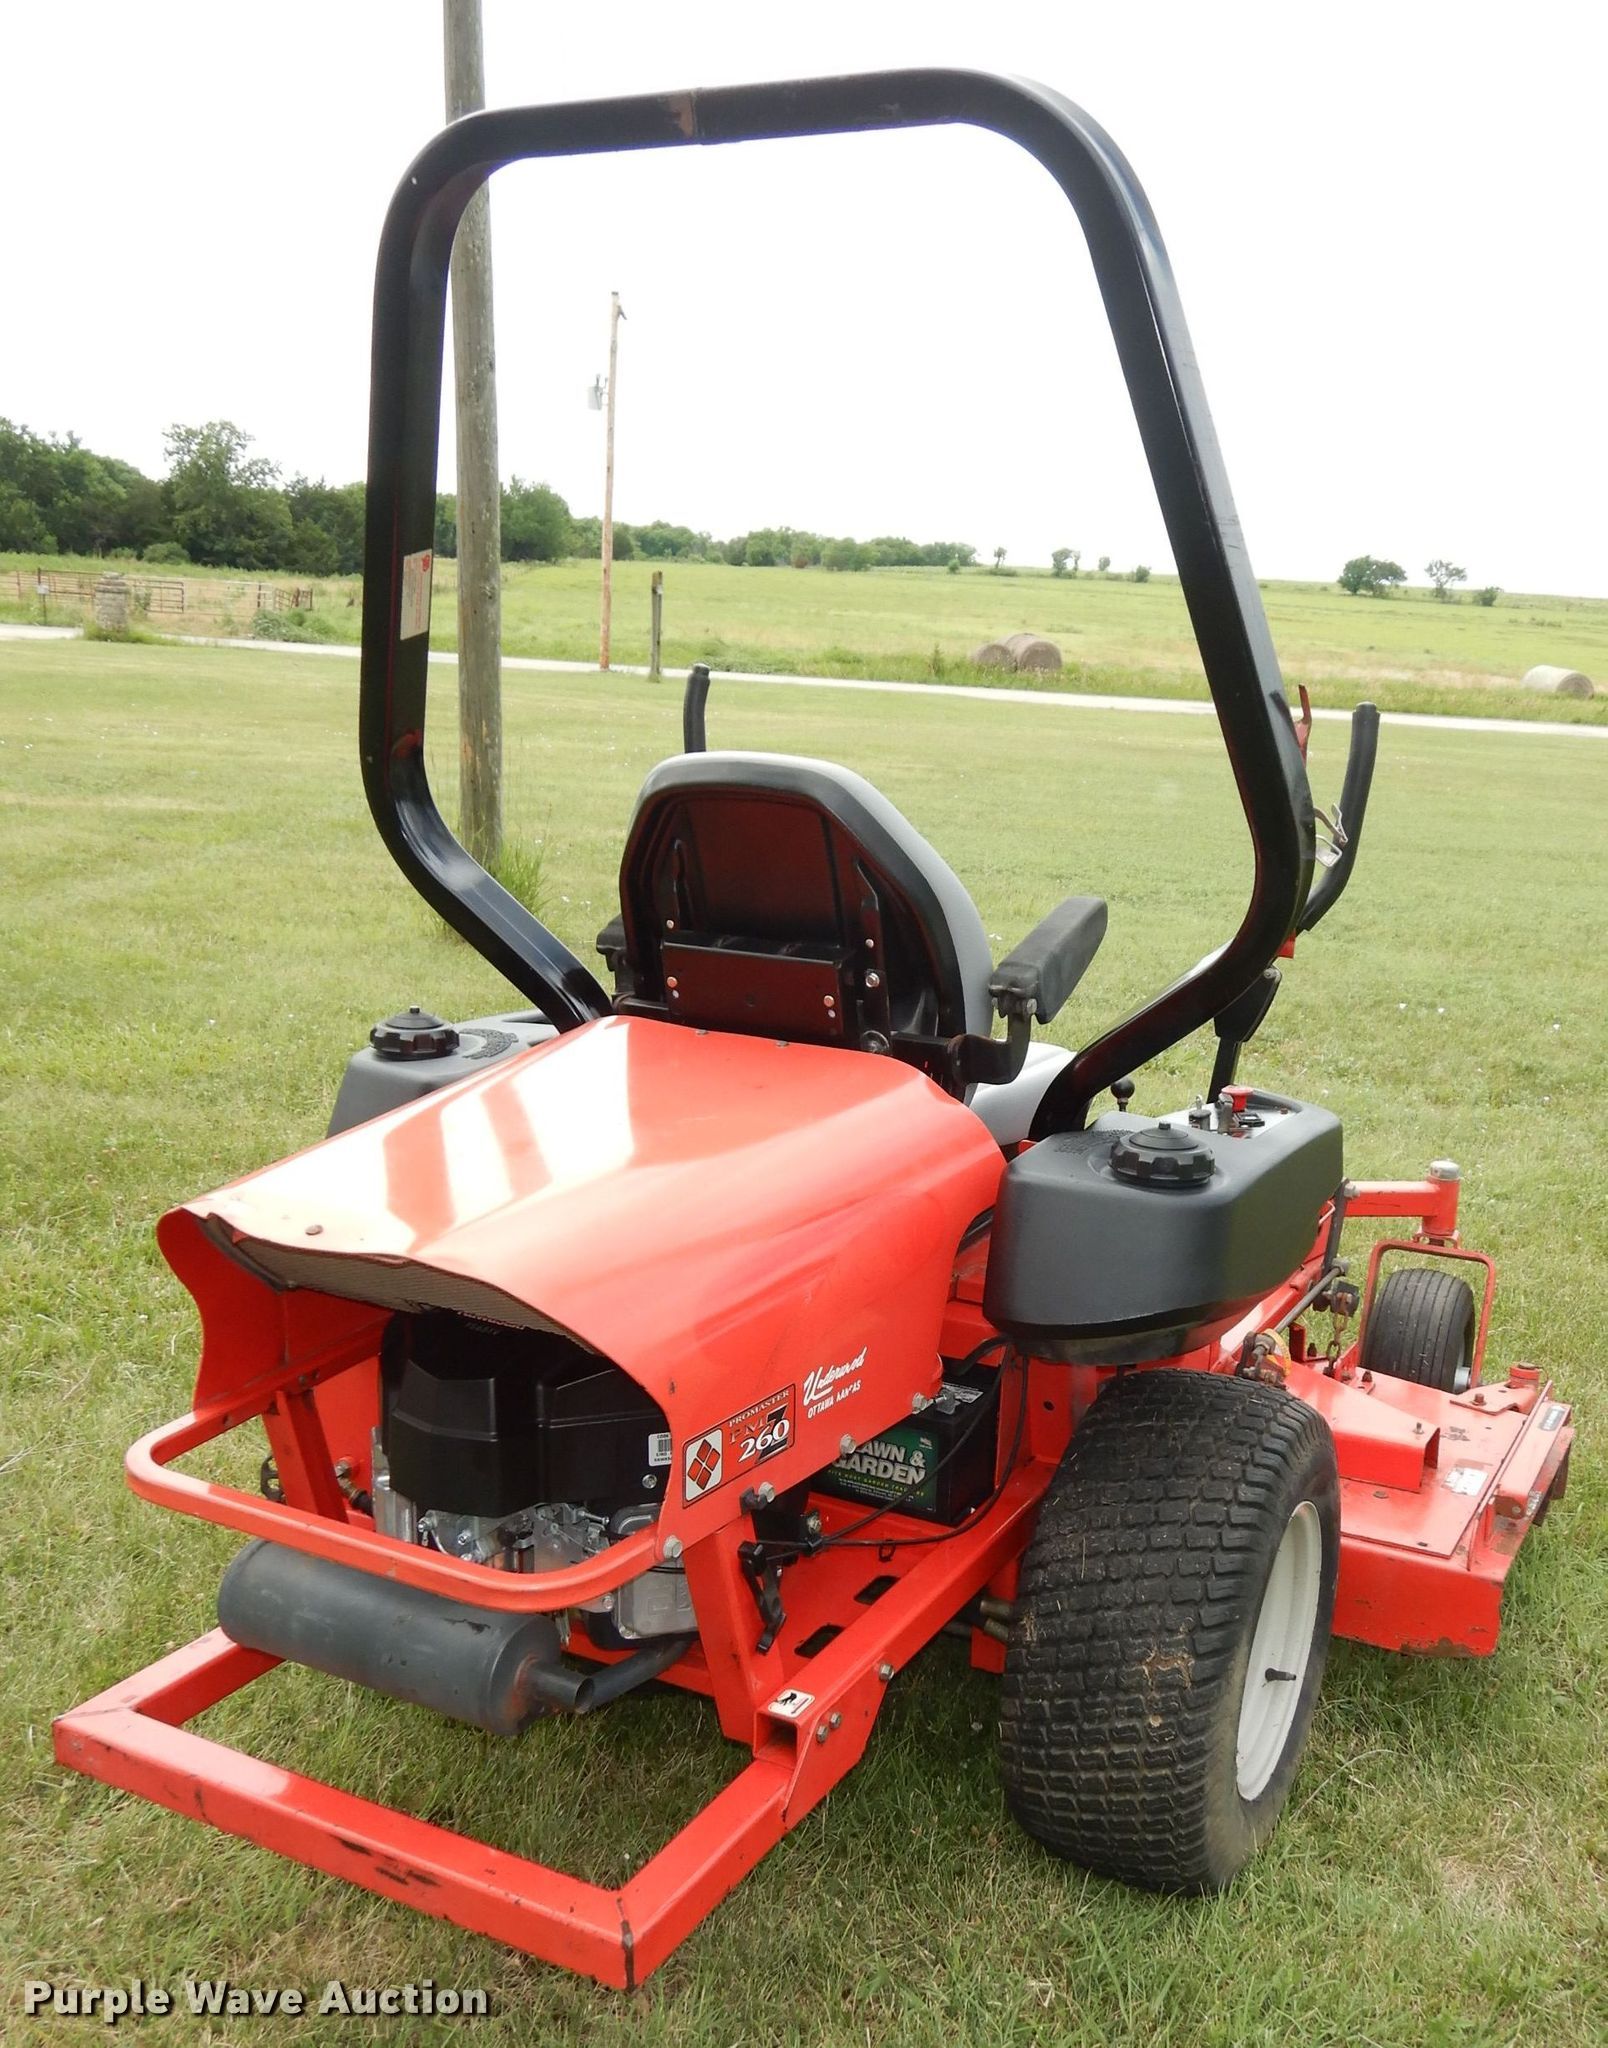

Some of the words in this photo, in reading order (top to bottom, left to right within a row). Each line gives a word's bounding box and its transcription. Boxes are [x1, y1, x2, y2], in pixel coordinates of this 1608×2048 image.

[729, 1390, 789, 1428] PROMASTER
[807, 1395, 834, 1419] OTTAWA
[738, 1418, 790, 1463] 260
[910, 1450, 926, 1468] &
